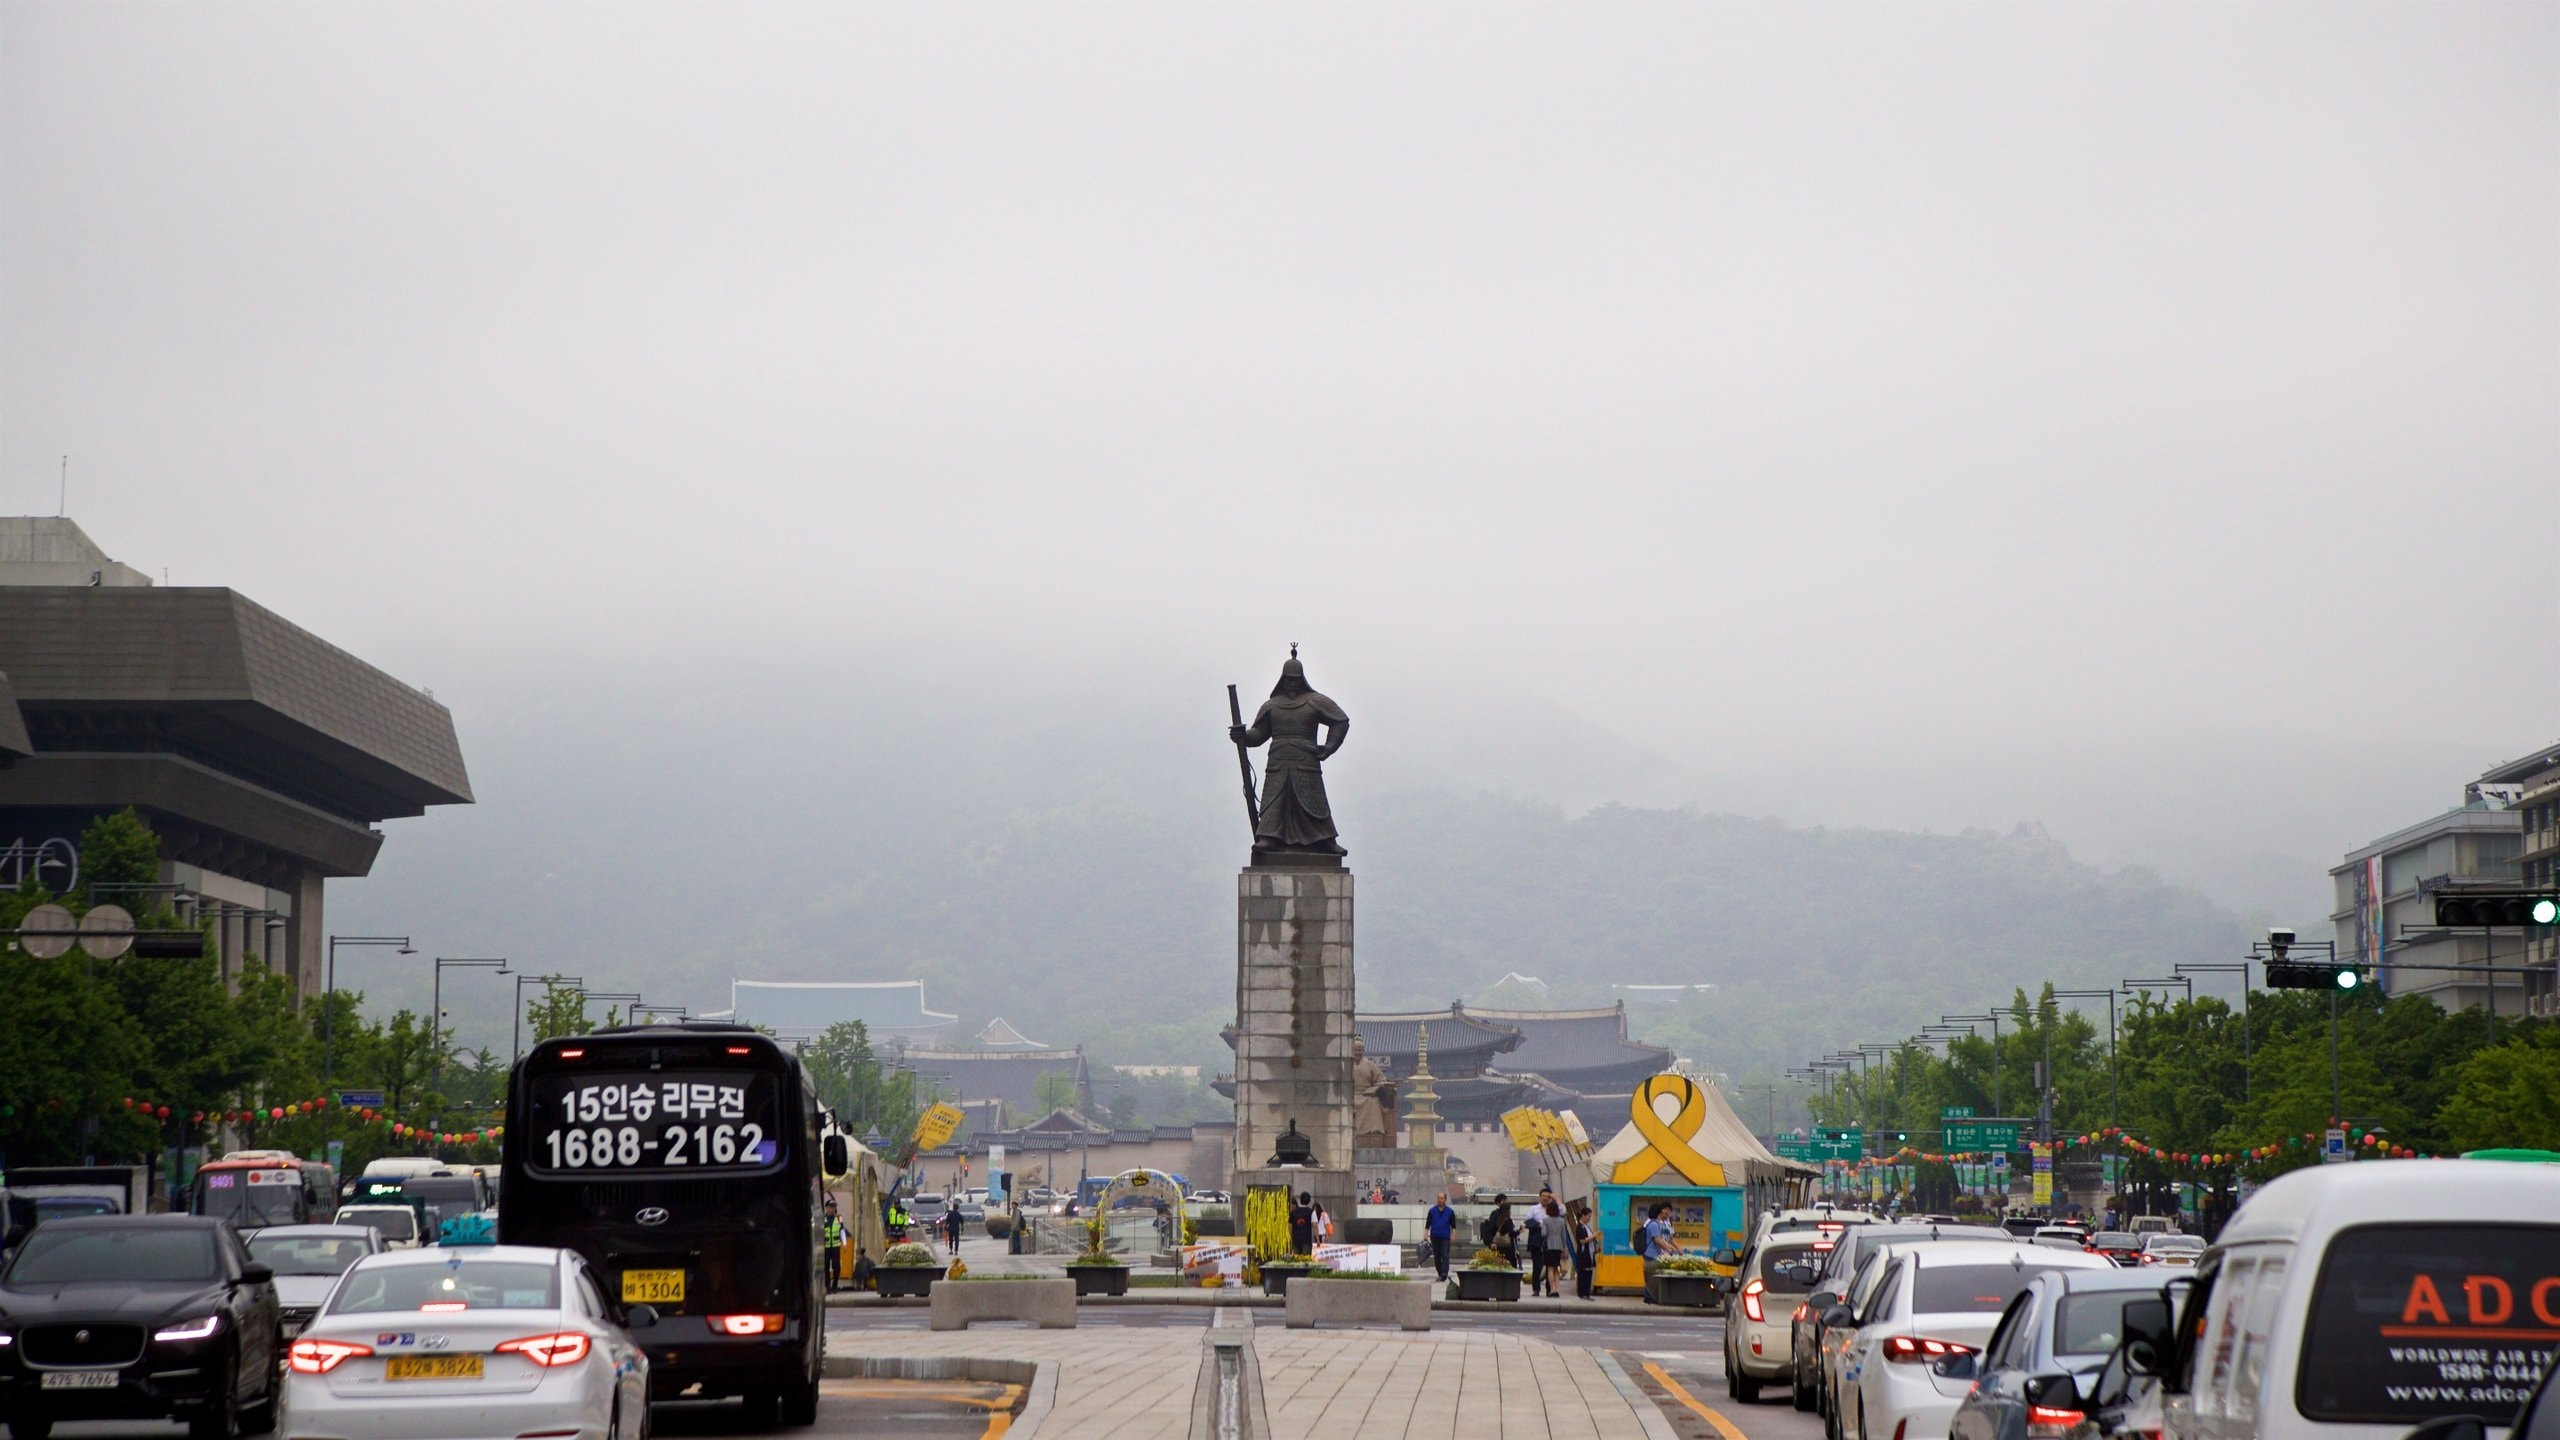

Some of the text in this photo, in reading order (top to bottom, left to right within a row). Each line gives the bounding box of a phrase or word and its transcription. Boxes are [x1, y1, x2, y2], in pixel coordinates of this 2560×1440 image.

[562, 1083, 745, 1123] 15인승 리무진
[546, 1123, 763, 1168] 1688-2162
[209, 1174, 234, 1189] 9401
[640, 1282, 681, 1298] 1304
[2390, 1347, 2489, 1364] WORLDWIDE
[2496, 1349, 2526, 1364] AIR
[2438, 1363, 2542, 1382] 1588-0444
[2386, 1384, 2535, 1402] www.adca
